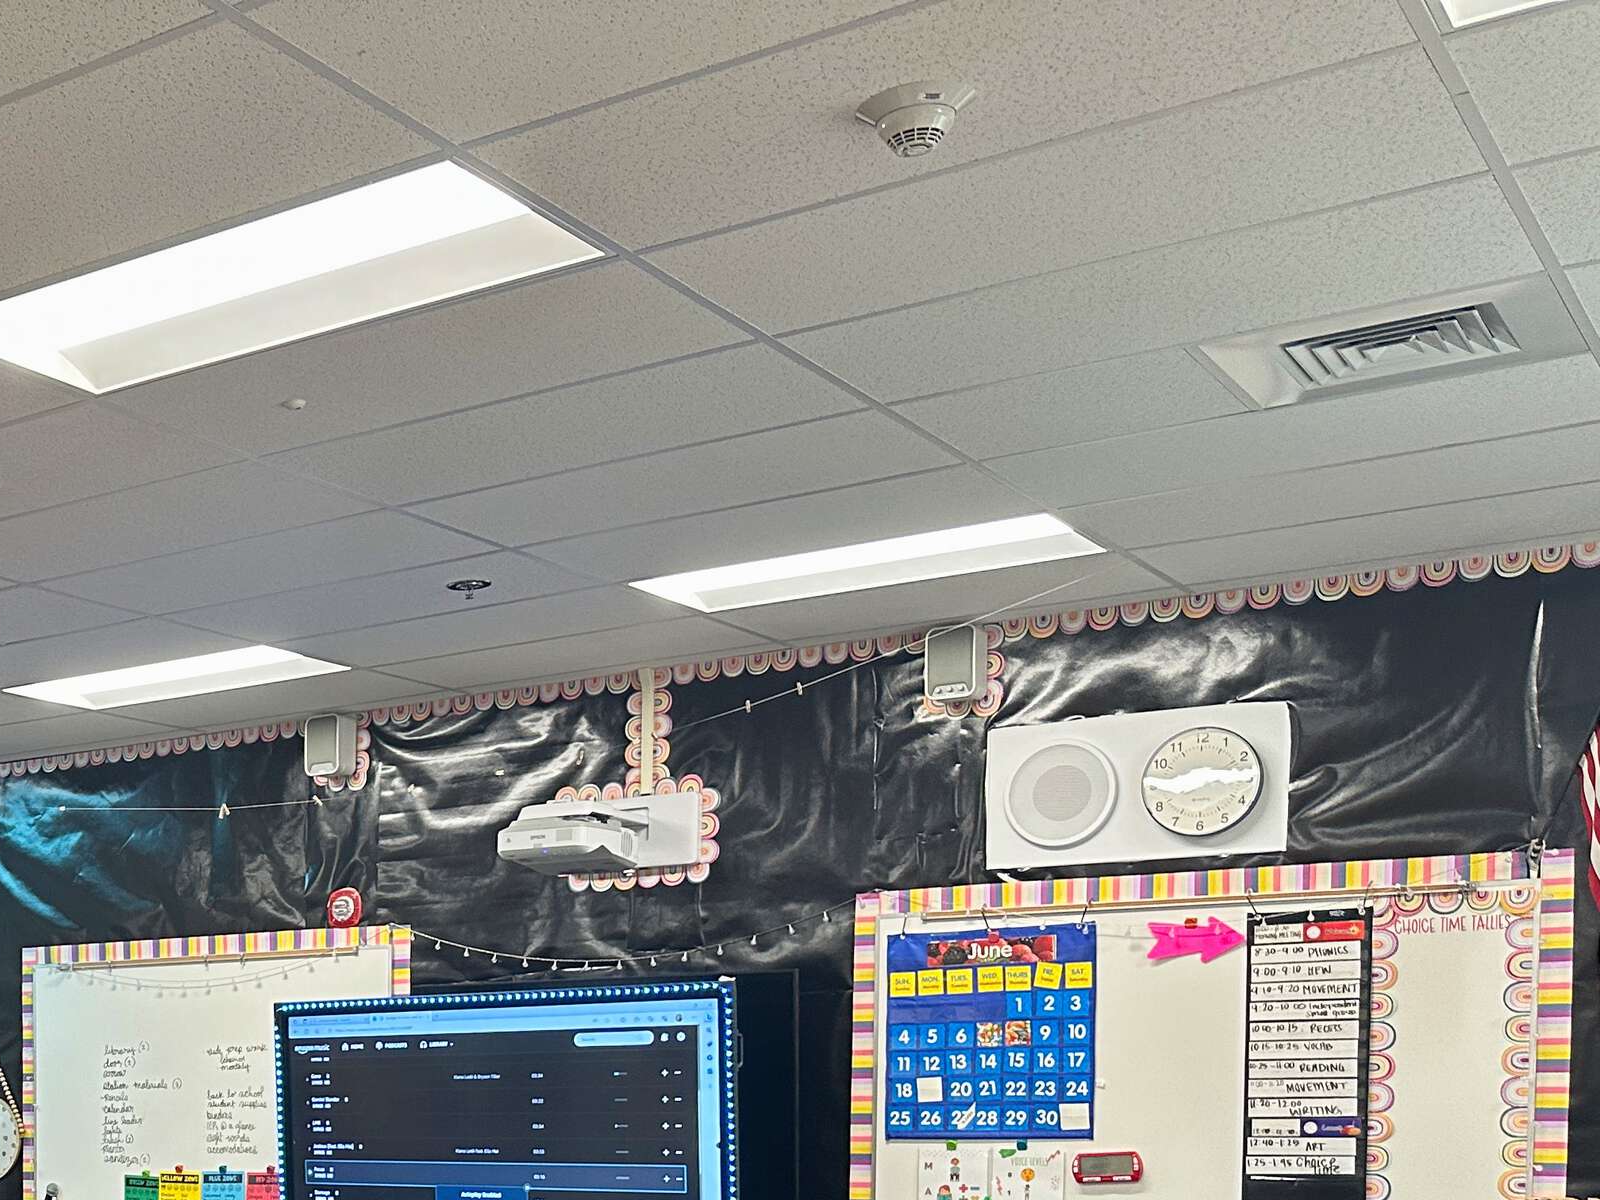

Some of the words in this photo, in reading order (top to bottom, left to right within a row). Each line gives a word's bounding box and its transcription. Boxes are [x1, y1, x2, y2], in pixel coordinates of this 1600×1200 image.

[1196, 733, 1209, 743] 12
[1223, 737, 1228, 747] 1
[1171, 742, 1182, 752] 11
[1240, 751, 1248, 761] 2
[1154, 758, 1168, 769] 10
[1238, 795, 1245, 805] 4
[1156, 802, 1163, 812] 8
[1172, 817, 1179, 826] 7
[1221, 813, 1228, 823] 5
[1196, 820, 1204, 831] 6
[1394, 918, 1436, 935] CHOICE
[1441, 916, 1466, 932] TIME
[1472, 914, 1512, 931] TALLIES
[967, 943, 1013, 960] June
[1307, 946, 1349, 958] PHONICS
[1303, 983, 1357, 995] MOVEMENT
[1015, 998, 1022, 1012] 1
[1043, 996, 1055, 1011] 2
[1070, 996, 1081, 1010] 3
[898, 1030, 910, 1043] 4
[927, 1029, 938, 1043] 5
[955, 1029, 967, 1043] 6
[1040, 1025, 1051, 1040] 9
[1068, 1024, 1087, 1039] 10
[897, 1057, 911, 1071] 11
[923, 1056, 940, 1071] 12
[949, 1055, 967, 1069] 13
[979, 1054, 997, 1069] 14
[1008, 1053, 1025, 1067] 15
[1037, 1053, 1055, 1067] 16
[1068, 1052, 1086, 1067] 17
[1300, 1063, 1345, 1072] READING
[896, 1083, 913, 1097] 18
[950, 1082, 972, 1097] 20
[979, 1081, 996, 1095] 21
[1005, 1082, 1026, 1096] 22
[1034, 1081, 1056, 1096] 23
[1066, 1081, 1088, 1096] 24
[1286, 1081, 1347, 1093] MOVEMENT
[1289, 1105, 1342, 1115] WRITING
[890, 1111, 911, 1126] 25
[920, 1111, 941, 1126] 26
[976, 1111, 998, 1126] 28
[1005, 1111, 1027, 1125] 29
[1035, 1110, 1058, 1125] 30
[1305, 1142, 1327, 1151] ART
[924, 1162, 933, 1170] M
[1296, 1156, 1336, 1169] Choice
[925, 1187, 932, 1195] A
